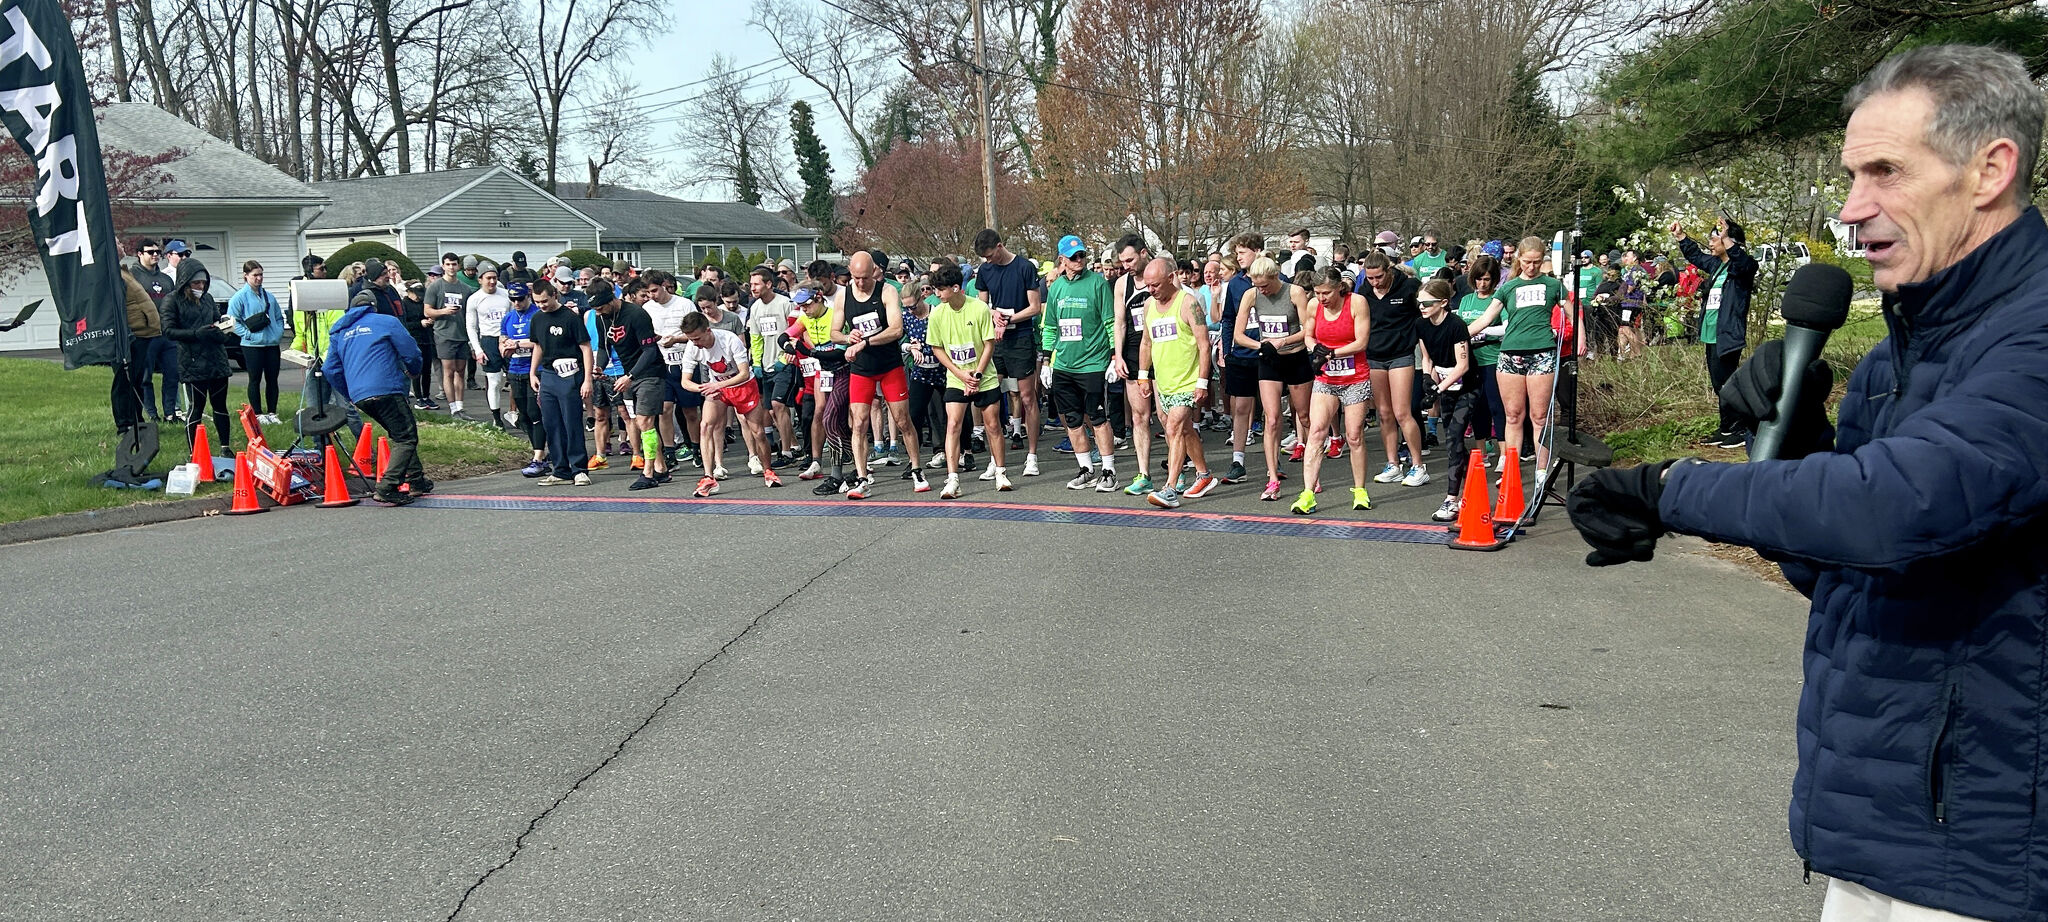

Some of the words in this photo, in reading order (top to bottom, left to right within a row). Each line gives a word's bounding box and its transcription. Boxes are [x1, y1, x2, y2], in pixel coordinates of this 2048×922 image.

[859, 319, 877, 333] 439
[1061, 325, 1077, 336] 530
[1155, 325, 1173, 338] 836
[1264, 322, 1283, 333] 879
[954, 349, 971, 361] 707
[1330, 358, 1349, 371] 681
